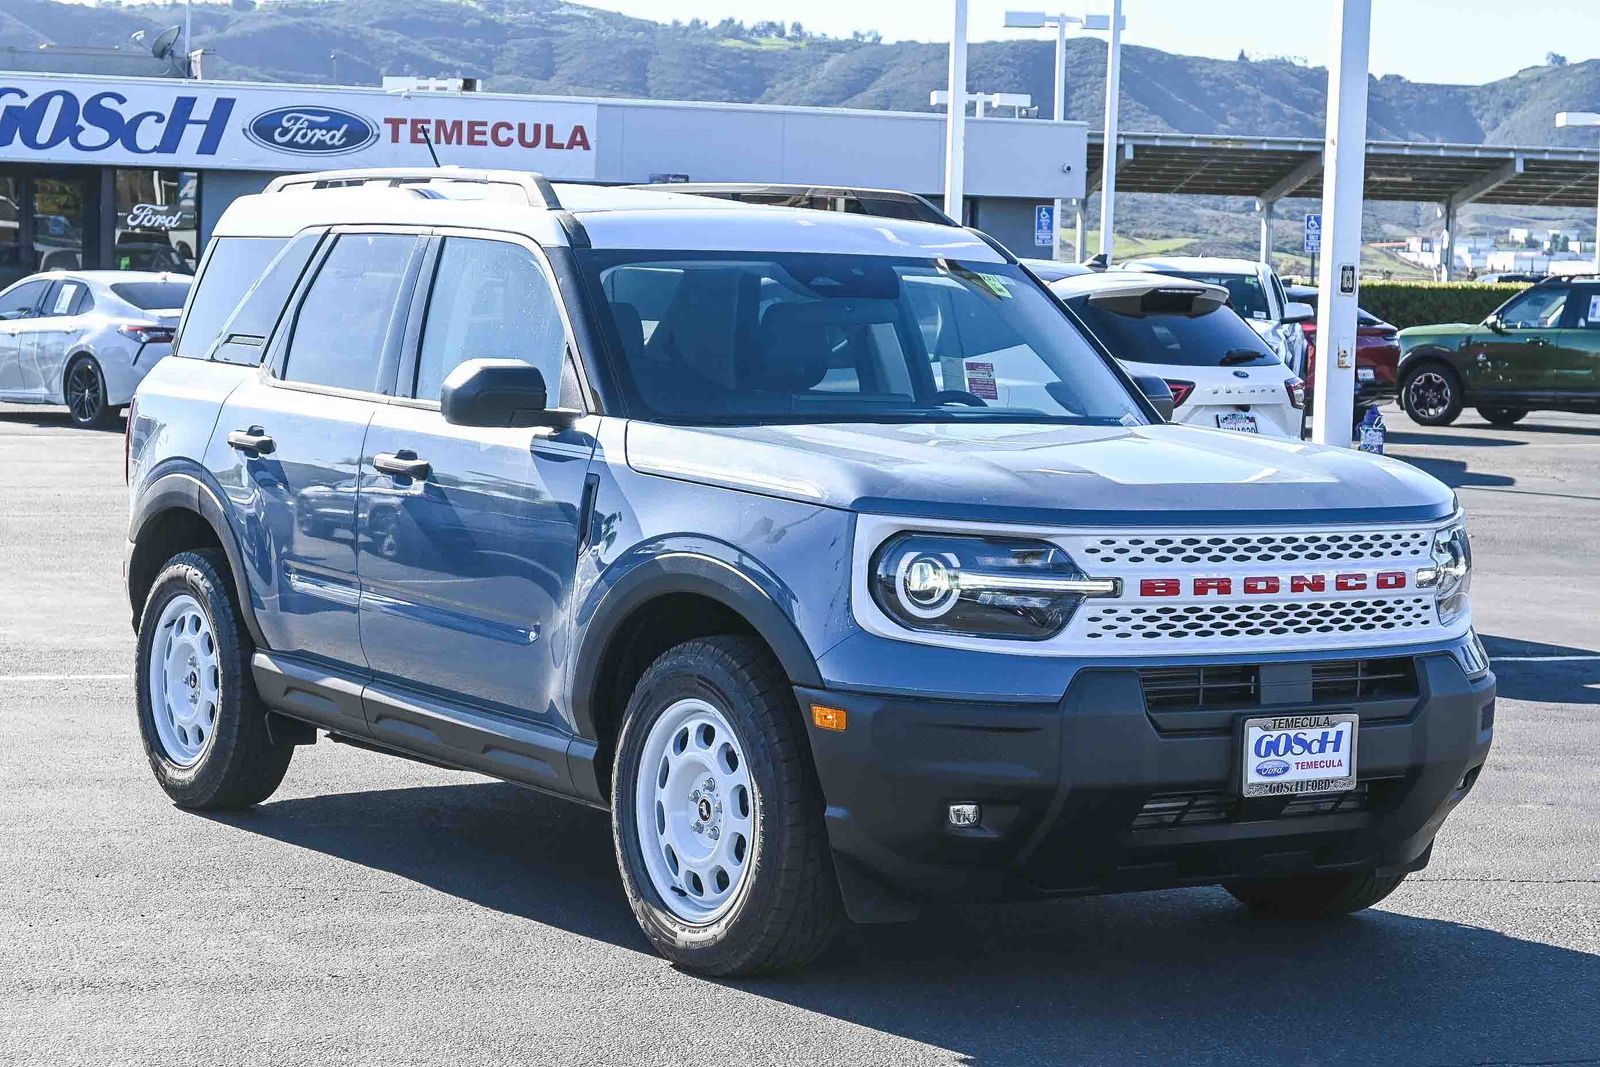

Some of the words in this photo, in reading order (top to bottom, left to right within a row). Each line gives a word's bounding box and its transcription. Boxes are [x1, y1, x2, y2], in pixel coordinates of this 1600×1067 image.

[274, 113, 348, 145] Ford
[384, 117, 591, 150] TEMECULA
[127, 203, 182, 228] Ford
[1140, 572, 1407, 596] BRONCO
[1272, 717, 1330, 729] TEMECULA
[1261, 762, 1284, 775] Ford
[1295, 759, 1343, 770] TEMECULA
[1305, 779, 1330, 791] FORD
